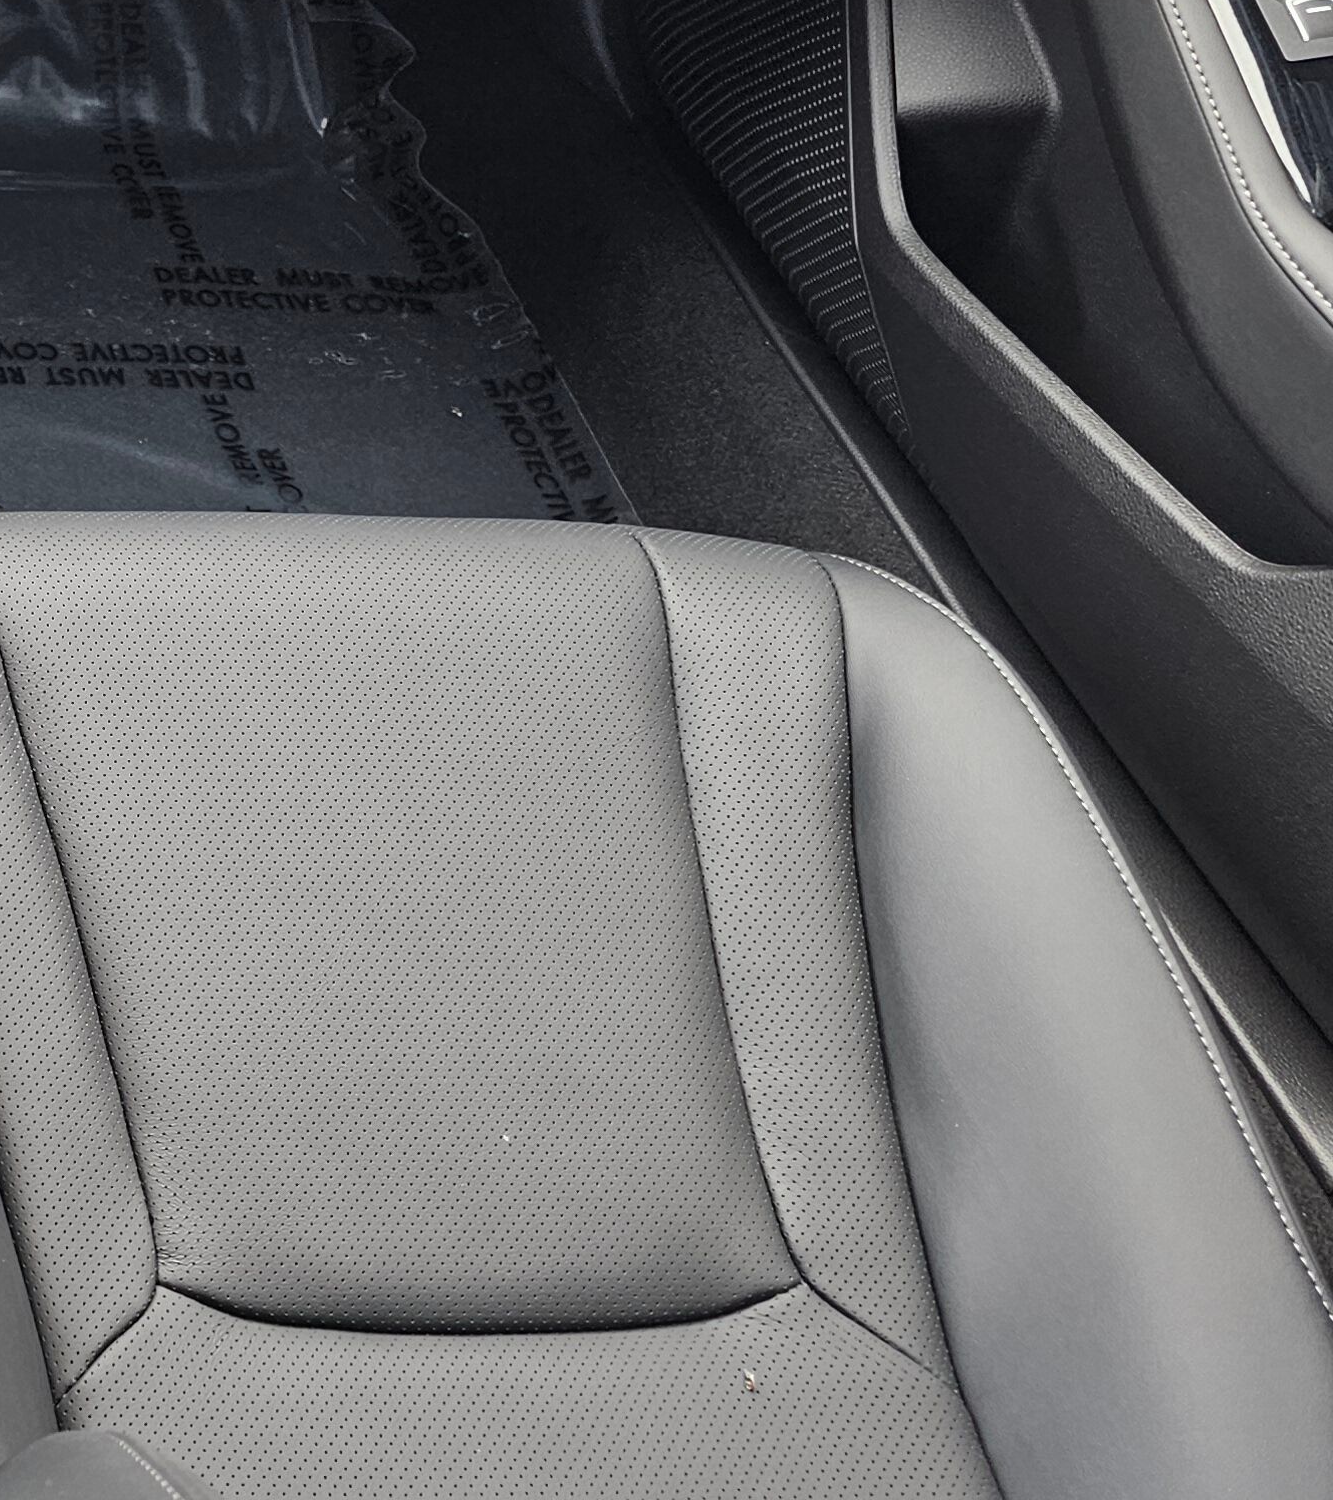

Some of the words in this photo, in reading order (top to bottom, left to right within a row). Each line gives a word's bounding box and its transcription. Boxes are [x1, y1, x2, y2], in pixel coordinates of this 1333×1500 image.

[153, 266, 260, 286] DEALER
[161, 289, 332, 313] PROTECTIVE
[73, 342, 247, 366] PROTECTIVE
[45, 366, 126, 387] MUST
[146, 367, 256, 392] DEALER
